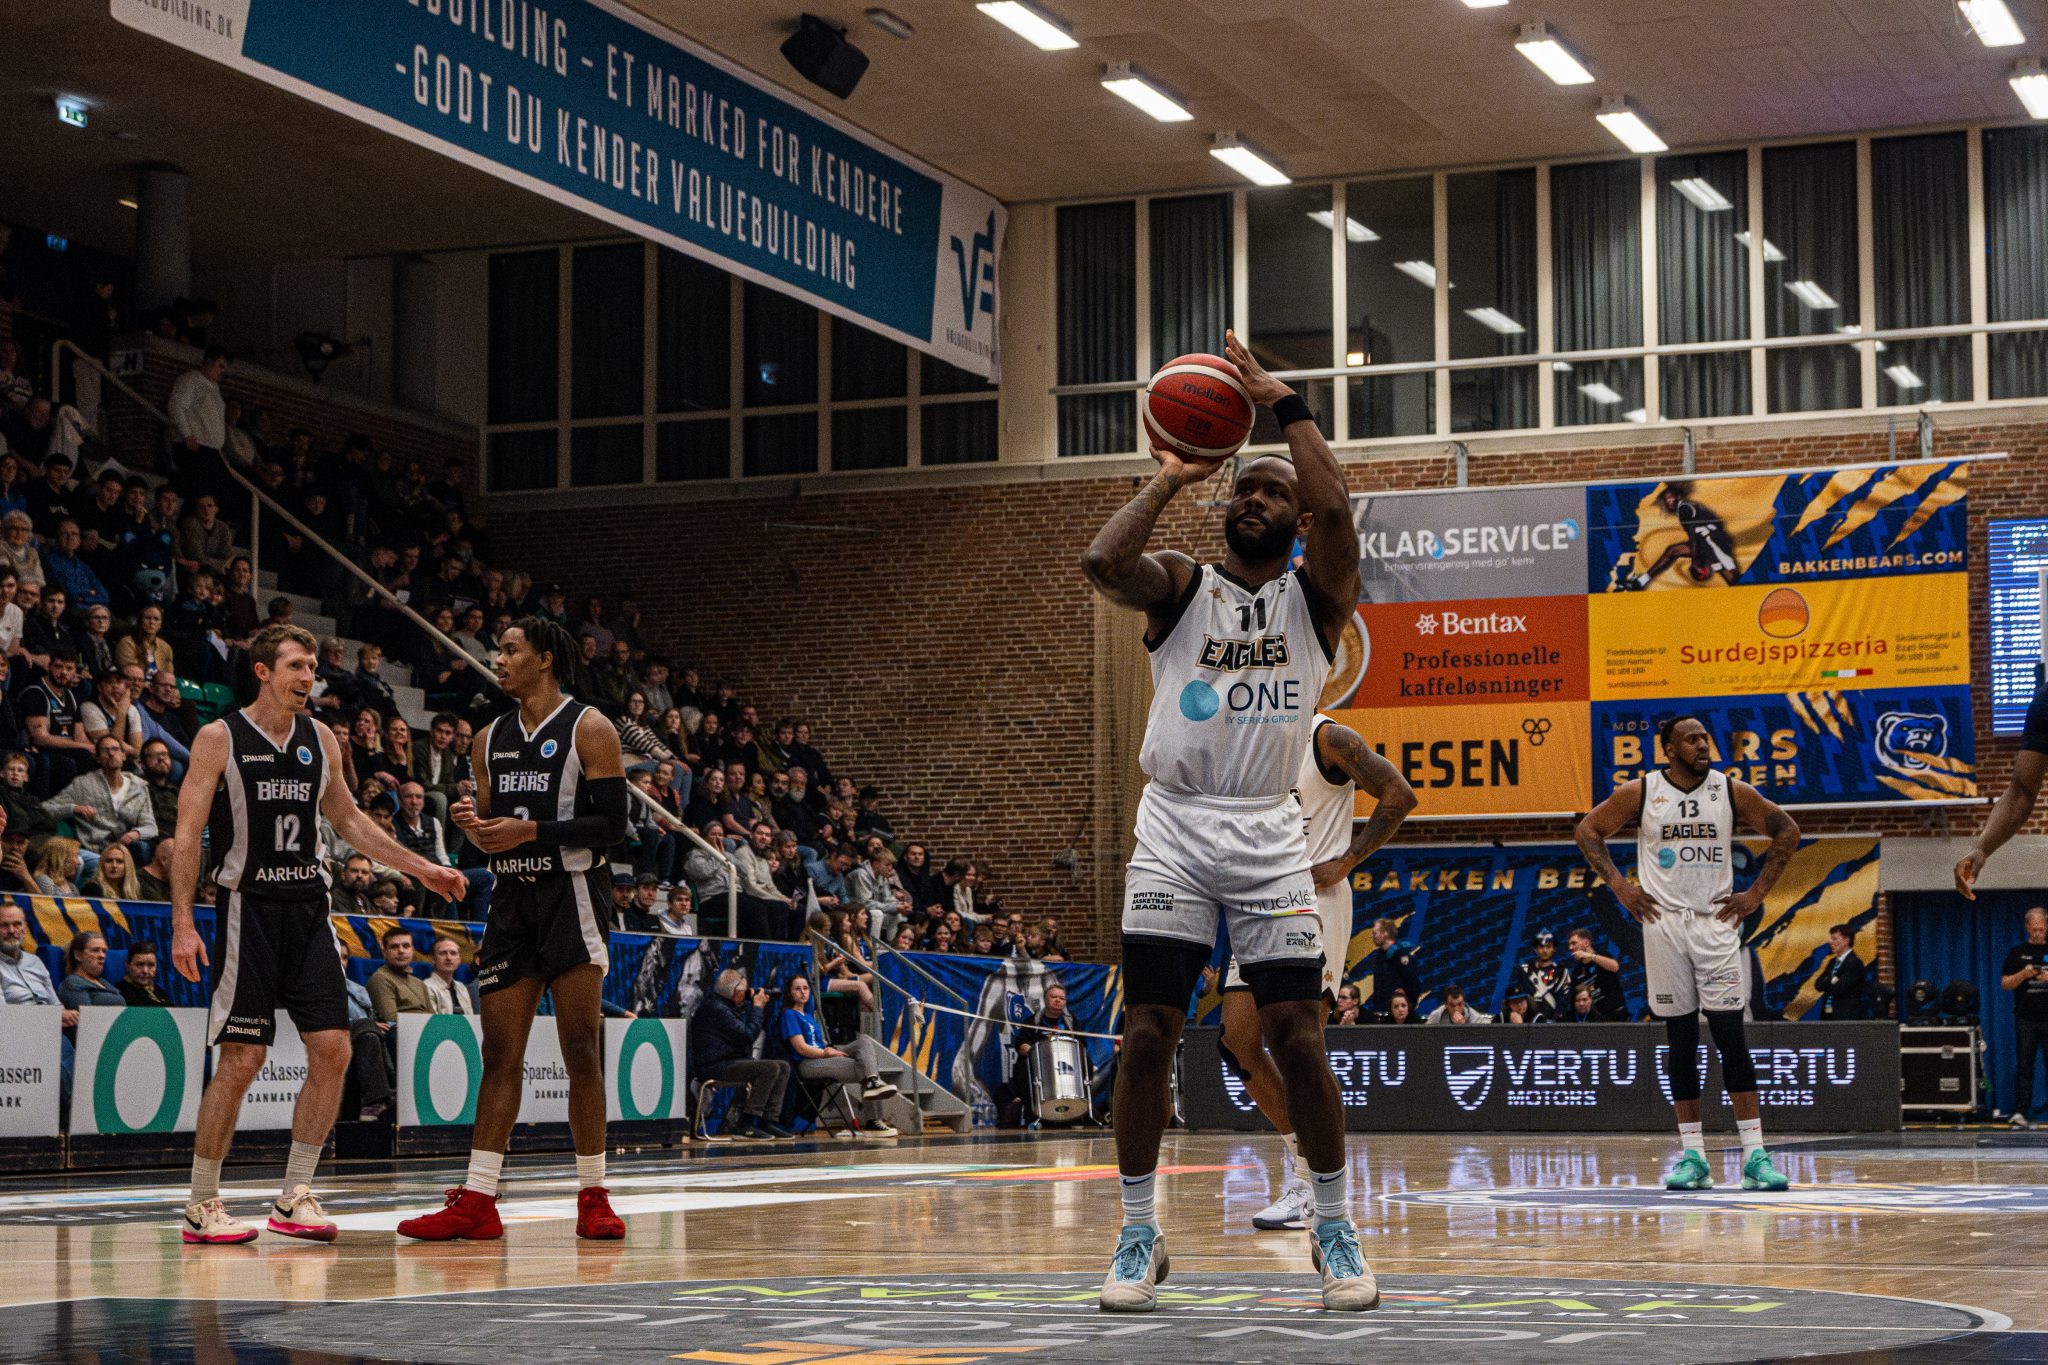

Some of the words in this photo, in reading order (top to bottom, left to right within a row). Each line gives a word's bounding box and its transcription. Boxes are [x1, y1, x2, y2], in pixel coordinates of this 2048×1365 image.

[607, 43, 634, 107] ET
[647, 63, 745, 159] MARKED
[758, 117, 799, 186] FOR
[812, 145, 902, 235] KENDERE
[507, 85, 542, 153] DU
[557, 108, 659, 205] KENDER
[671, 159, 856, 290] VALUEBUILDING
[1183, 382, 1231, 408] molten
[1360, 530, 1434, 559] KLAR
[1444, 523, 1569, 555] SERVICE
[1779, 551, 1963, 575] BAKKENBEARS.COM
[1235, 597, 1267, 632] 11
[1441, 612, 1527, 635] Bentax
[1197, 634, 1290, 672] EAGLES
[1402, 645, 1561, 670] Professionelle
[1680, 636, 1888, 665] Surdejspizzeria
[1227, 680, 1300, 711] ONE
[1400, 676, 1564, 698] kaffeløsninger
[1271, 714, 1299, 723] GROUP
[242, 754, 275, 763] SPALDING
[492, 751, 520, 760] SPALDING
[256, 782, 312, 802] BEARS
[498, 773, 552, 792] BEARS
[1678, 800, 1700, 819] 13
[275, 814, 301, 852] 12
[1662, 823, 1717, 841] EAGLES
[496, 857, 552, 873] AARHUS
[1680, 846, 1723, 863] ONE
[255, 865, 317, 881] AARHUS
[1352, 869, 1516, 892] BAKKEN
[226, 1025, 261, 1037] SPALDING
[1502, 1049, 1638, 1086] VERTU
[1507, 1090, 1598, 1106] MOTORS
[487, 1311, 1173, 1336] BOLIG
[1196, 1325, 1646, 1344] JCN
